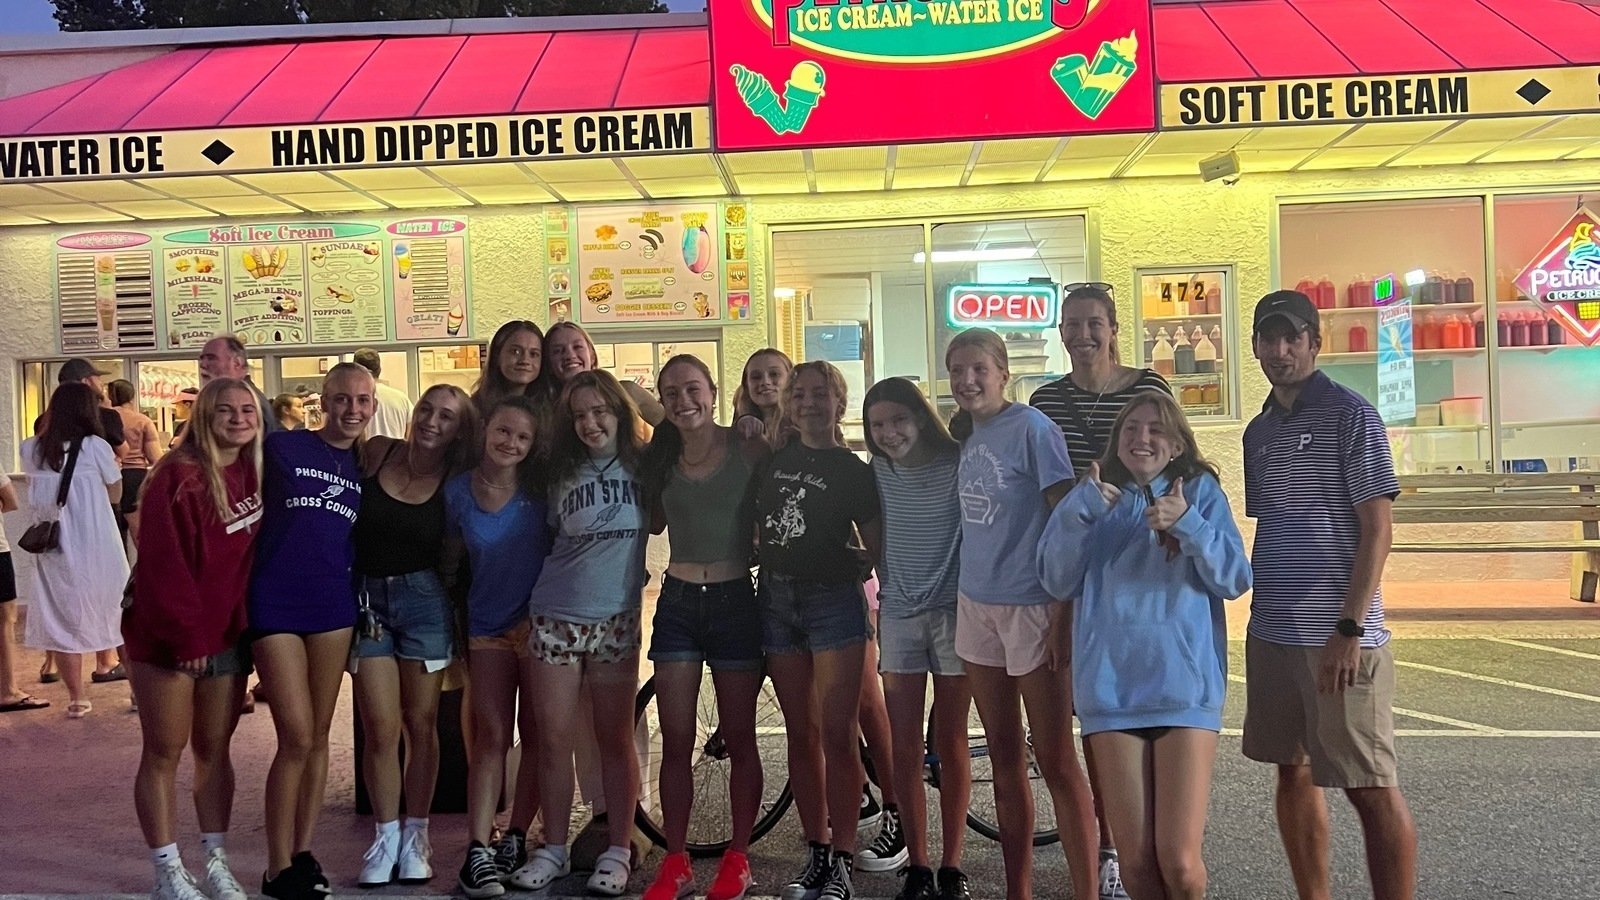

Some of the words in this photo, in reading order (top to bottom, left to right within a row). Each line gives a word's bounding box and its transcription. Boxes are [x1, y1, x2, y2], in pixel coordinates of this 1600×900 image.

[796, 10, 832, 32] ICE
[1007, 2, 1044, 22] ICE
[1179, 85, 1266, 125] SOFT
[1278, 82, 1335, 120] ICE
[1345, 76, 1469, 117] CREAM
[271, 127, 365, 166] HAND
[375, 121, 498, 162] DIPPED
[509, 118, 564, 156] ICE
[573, 112, 693, 153] CREAM
[109, 136, 164, 173] ICE
[209, 227, 243, 242] Soft
[248, 226, 273, 241] Ice
[277, 225, 334, 240] Cream
[397, 222, 433, 234] WATER
[437, 220, 456, 232] ICE
[168, 248, 220, 259] SMOOTHIES
[167, 275, 224, 288] MILKSHAKES
[232, 286, 303, 301] MEGA-BLENDS
[171, 307, 222, 317] CAPPUCCINO
[177, 301, 213, 311] FROZEN
[956, 294, 1049, 320] OPEN
[234, 315, 260, 326] SWEET
[261, 313, 304, 323] ADDITIONS
[406, 313, 444, 324] GELATI
[1297, 433, 1313, 451] P
[773, 469, 802, 482] Rough
[286, 496, 322, 508] CROSS
[561, 481, 595, 518] PENN
